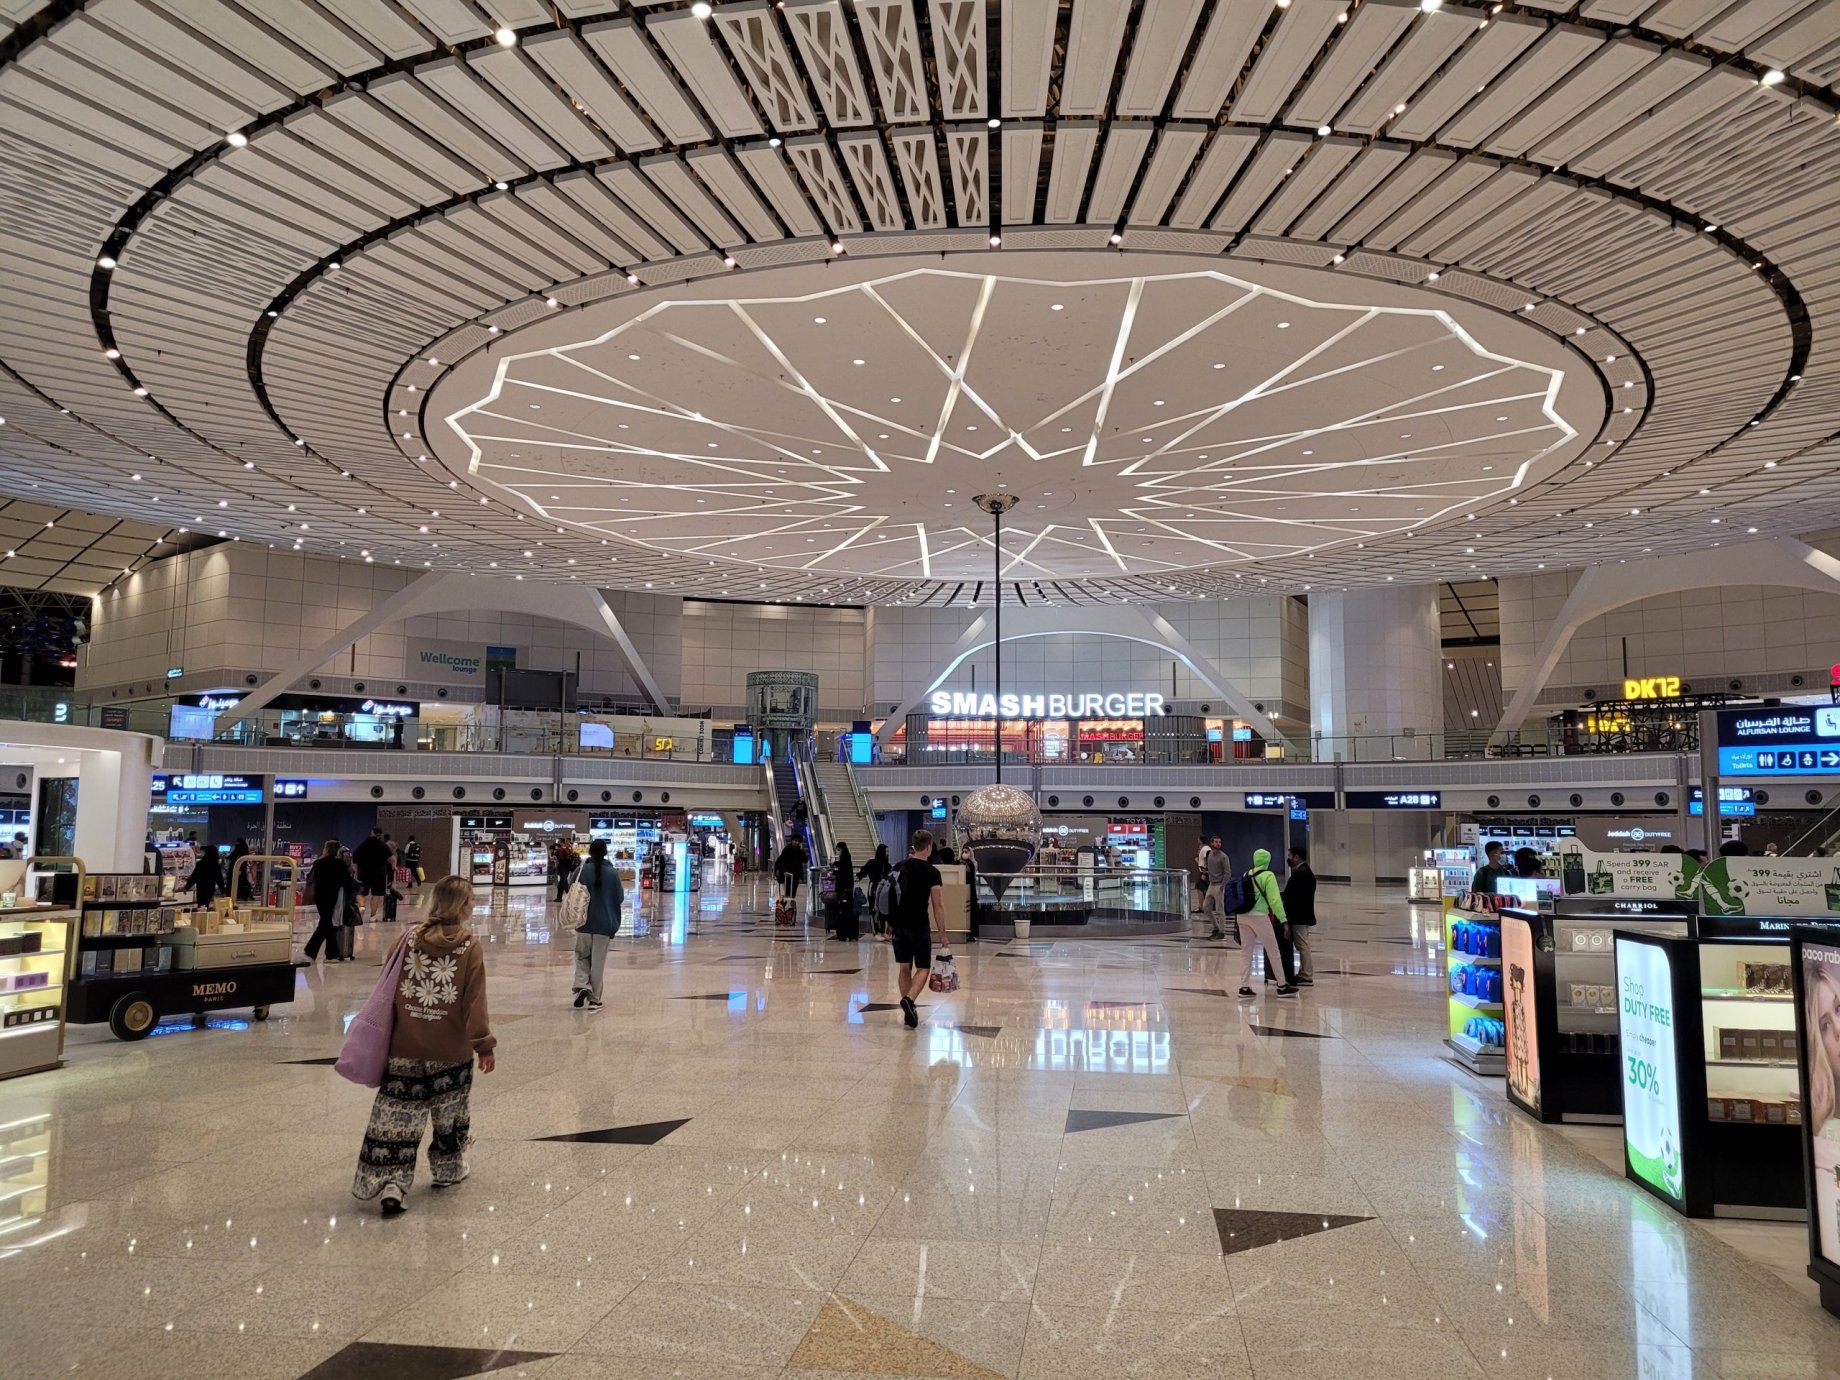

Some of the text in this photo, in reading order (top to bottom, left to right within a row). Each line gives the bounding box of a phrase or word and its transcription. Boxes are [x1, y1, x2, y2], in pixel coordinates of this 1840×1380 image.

[420, 651, 480, 667] Wellcome
[452, 665, 477, 675] lounge
[1624, 677, 1680, 700] DK12
[1736, 716, 1811, 729] صالة الفرسان
[1737, 725, 1811, 736] ALFURSAN LOUNGE
[1400, 795, 1419, 805] A28
[1606, 860, 1631, 868] Spend
[1632, 859, 1651, 867] 399
[1752, 869, 1771, 877] 399
[1760, 921, 1793, 930] MARIN
[1802, 948, 1823, 961] paco
[192, 981, 237, 996] MEMO
[1624, 976, 1644, 998] Shop
[1624, 997, 1671, 1027] DUTY FREE
[1639, 1033, 1656, 1048] cheaper
[1628, 1055, 1659, 1096] 30%
